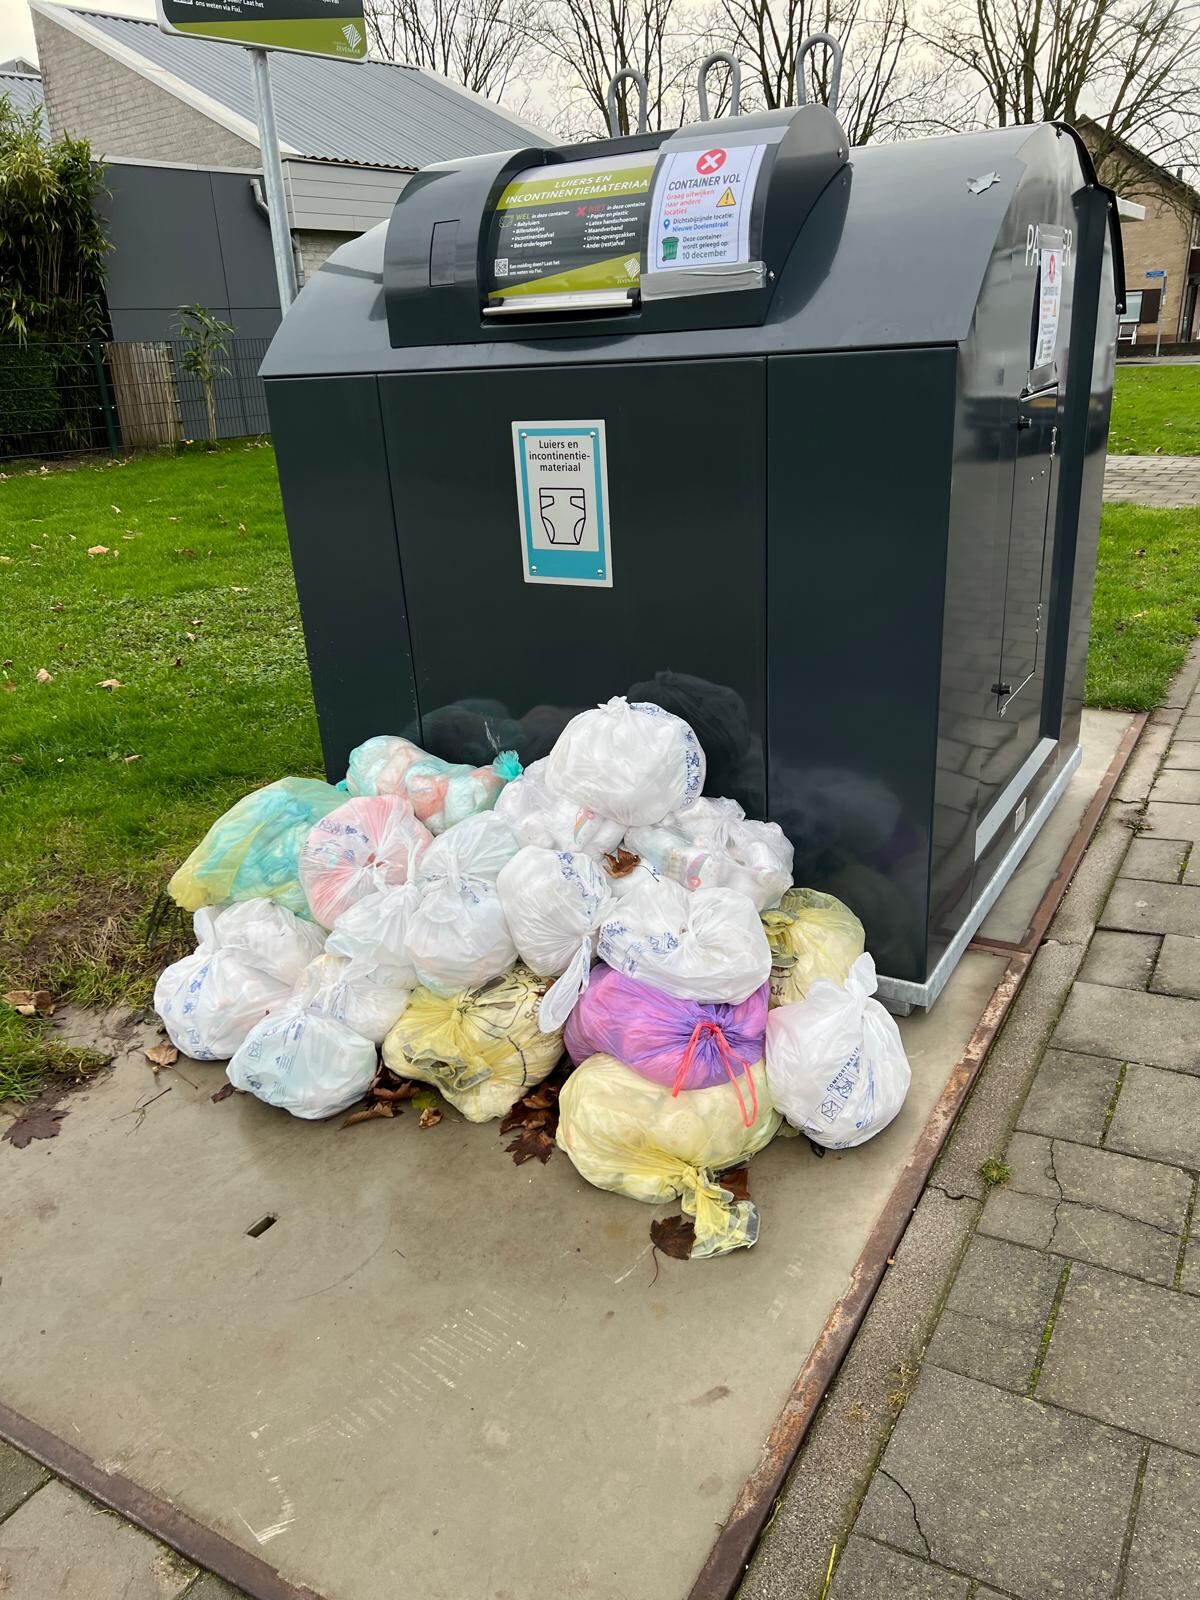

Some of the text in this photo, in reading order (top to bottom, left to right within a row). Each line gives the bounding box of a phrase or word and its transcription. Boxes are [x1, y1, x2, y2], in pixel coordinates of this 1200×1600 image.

[206, 2, 223, 10] weten
[554, 174, 612, 188] LUIERS EN
[668, 173, 741, 191] CONTAINER VOL
[505, 179, 648, 204] INCONTINENTIEMATERIAA
[612, 210, 630, 218] plastic
[663, 207, 688, 216] locaties
[602, 217, 638, 225] handschoenen
[693, 221, 729, 230] Doelenstraat
[587, 224, 624, 234] Maandverband
[586, 232, 636, 241] Urine-opvangzakken
[682, 233, 722, 243] Deze container
[523, 240, 552, 248] onderleggers
[600, 240, 626, 249] (rest)afval
[699, 241, 719, 249] geleegd
[1025, 224, 1072, 266] PAR
[682, 249, 727, 260] 10 december
[539, 440, 579, 449] Luiers en
[529, 451, 590, 460] incontinentie-
[539, 462, 581, 471] materiaal
[826, 1046, 859, 1092] COMFORTWASTE
